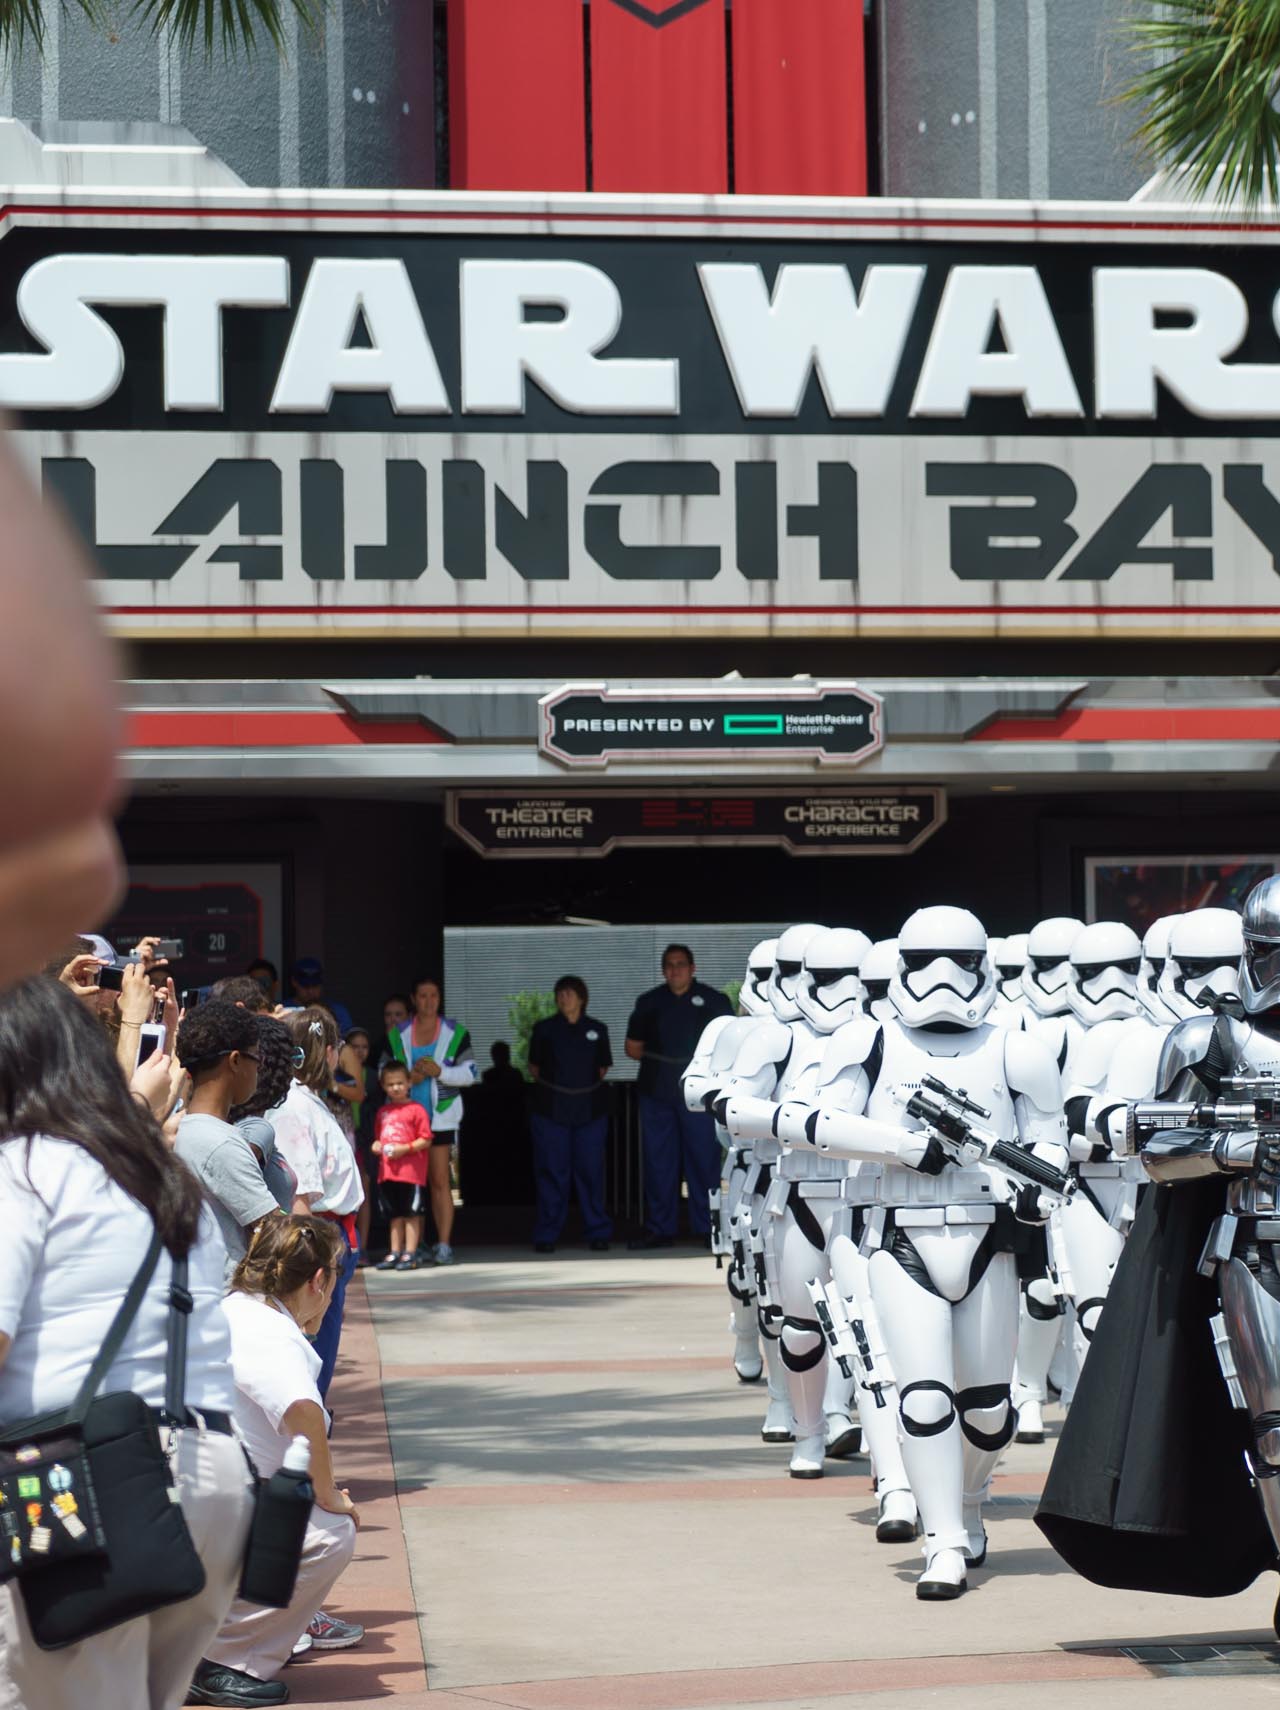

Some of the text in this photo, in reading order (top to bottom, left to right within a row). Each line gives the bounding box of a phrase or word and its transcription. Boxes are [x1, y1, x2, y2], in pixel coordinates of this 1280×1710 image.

[0, 254, 680, 416] STAR
[41, 457, 858, 580] LAUNCH
[563, 718, 716, 732] PRESENTED BY
[786, 714, 864, 725] Hewlett Packard
[786, 725, 835, 736] Enterprise
[804, 824, 900, 836] EXPERIENCE
[208, 932, 226, 951] 20
